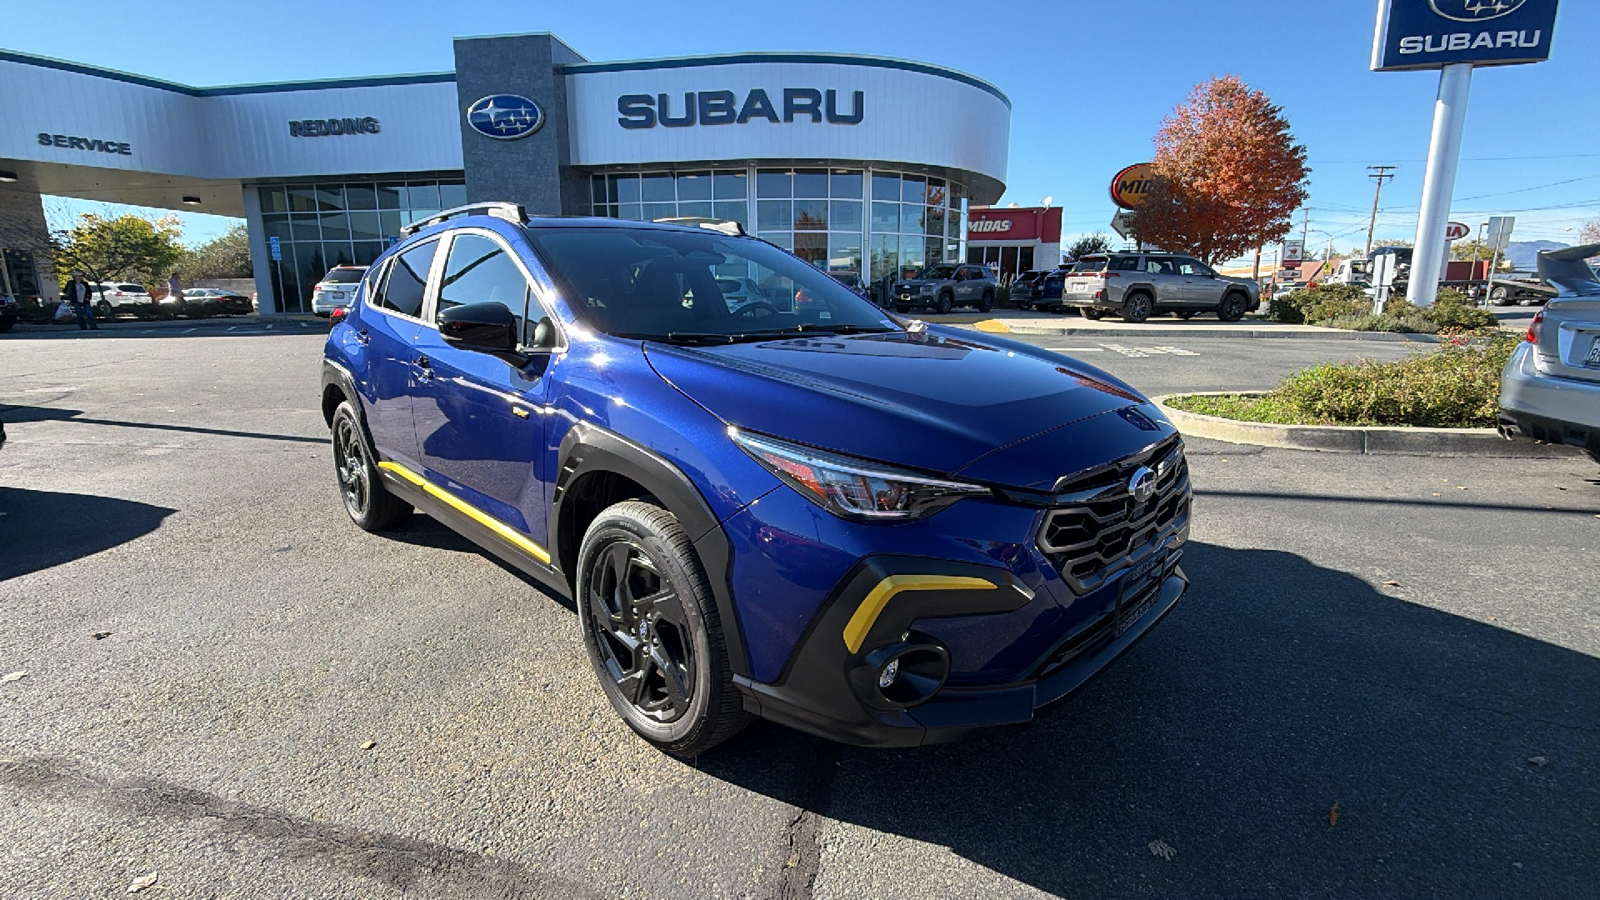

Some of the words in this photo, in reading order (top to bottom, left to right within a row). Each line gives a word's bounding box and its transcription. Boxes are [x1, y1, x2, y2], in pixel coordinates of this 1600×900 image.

[1399, 29, 1541, 54] SUBARU
[617, 88, 864, 129] SUBARU
[288, 116, 381, 137] REDDING
[38, 132, 132, 156] SERVICE
[1119, 179, 1152, 195] MID
[968, 219, 1012, 233] MIDAS
